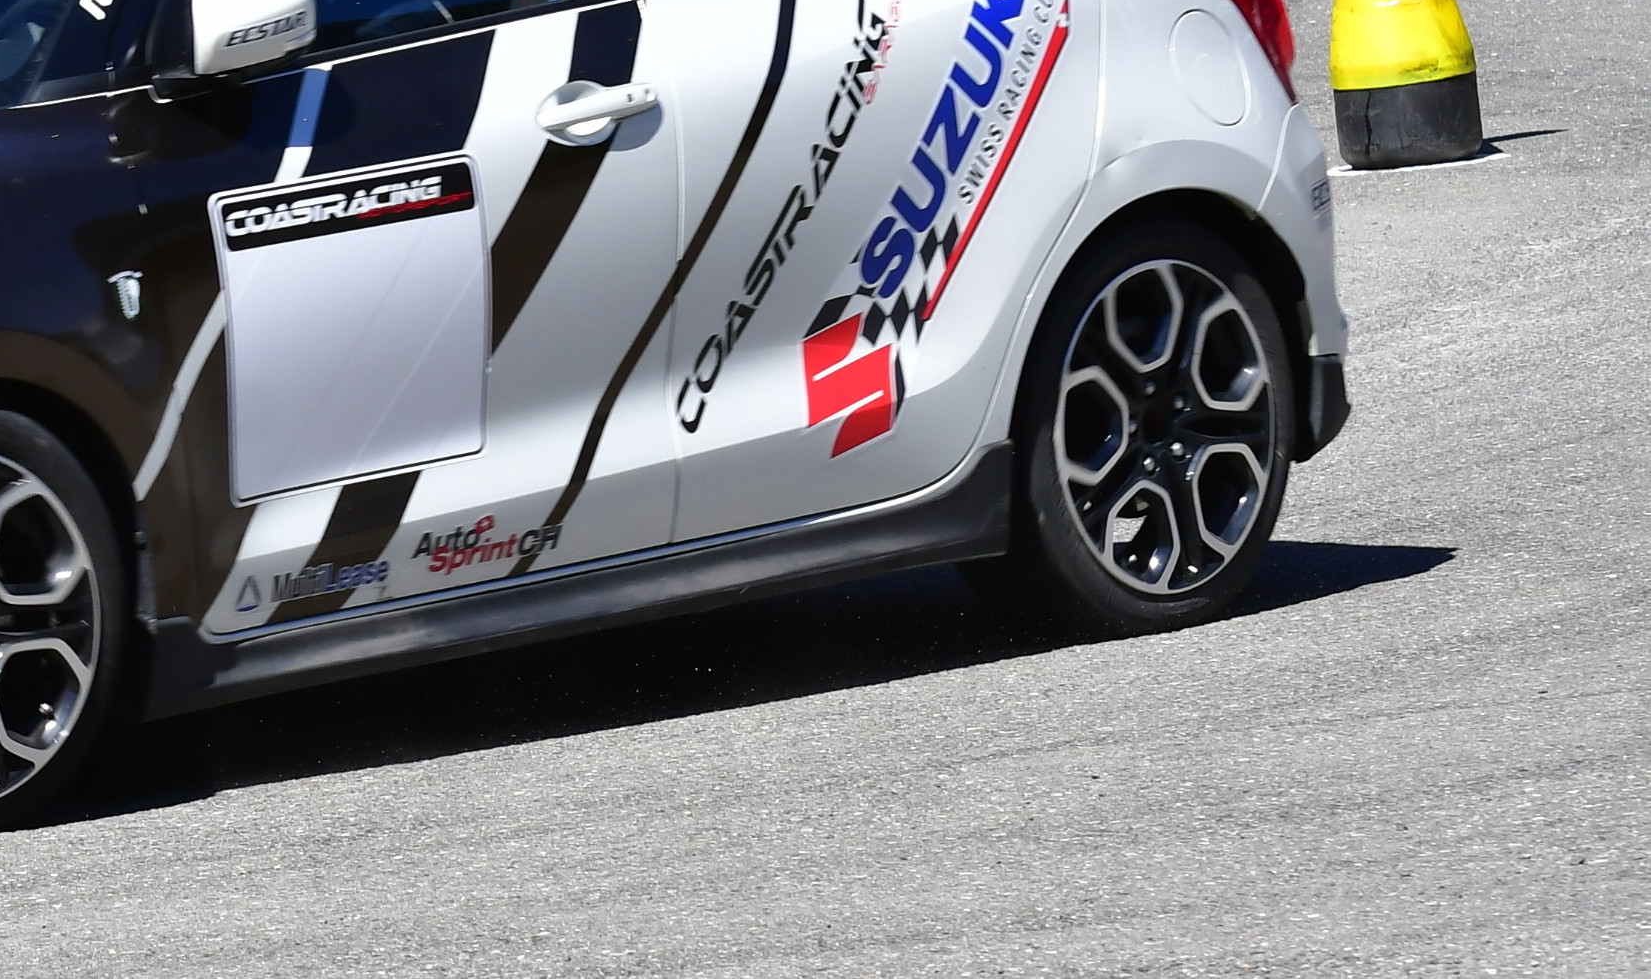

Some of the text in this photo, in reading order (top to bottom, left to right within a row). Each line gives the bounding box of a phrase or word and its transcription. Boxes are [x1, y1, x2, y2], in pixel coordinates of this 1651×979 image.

[224, 8, 309, 48] ECSTAR
[957, 123, 1005, 205] SWISS
[997, 26, 1043, 121] RACING
[225, 175, 443, 237] COASTRACING
[411, 524, 481, 560] Auto
